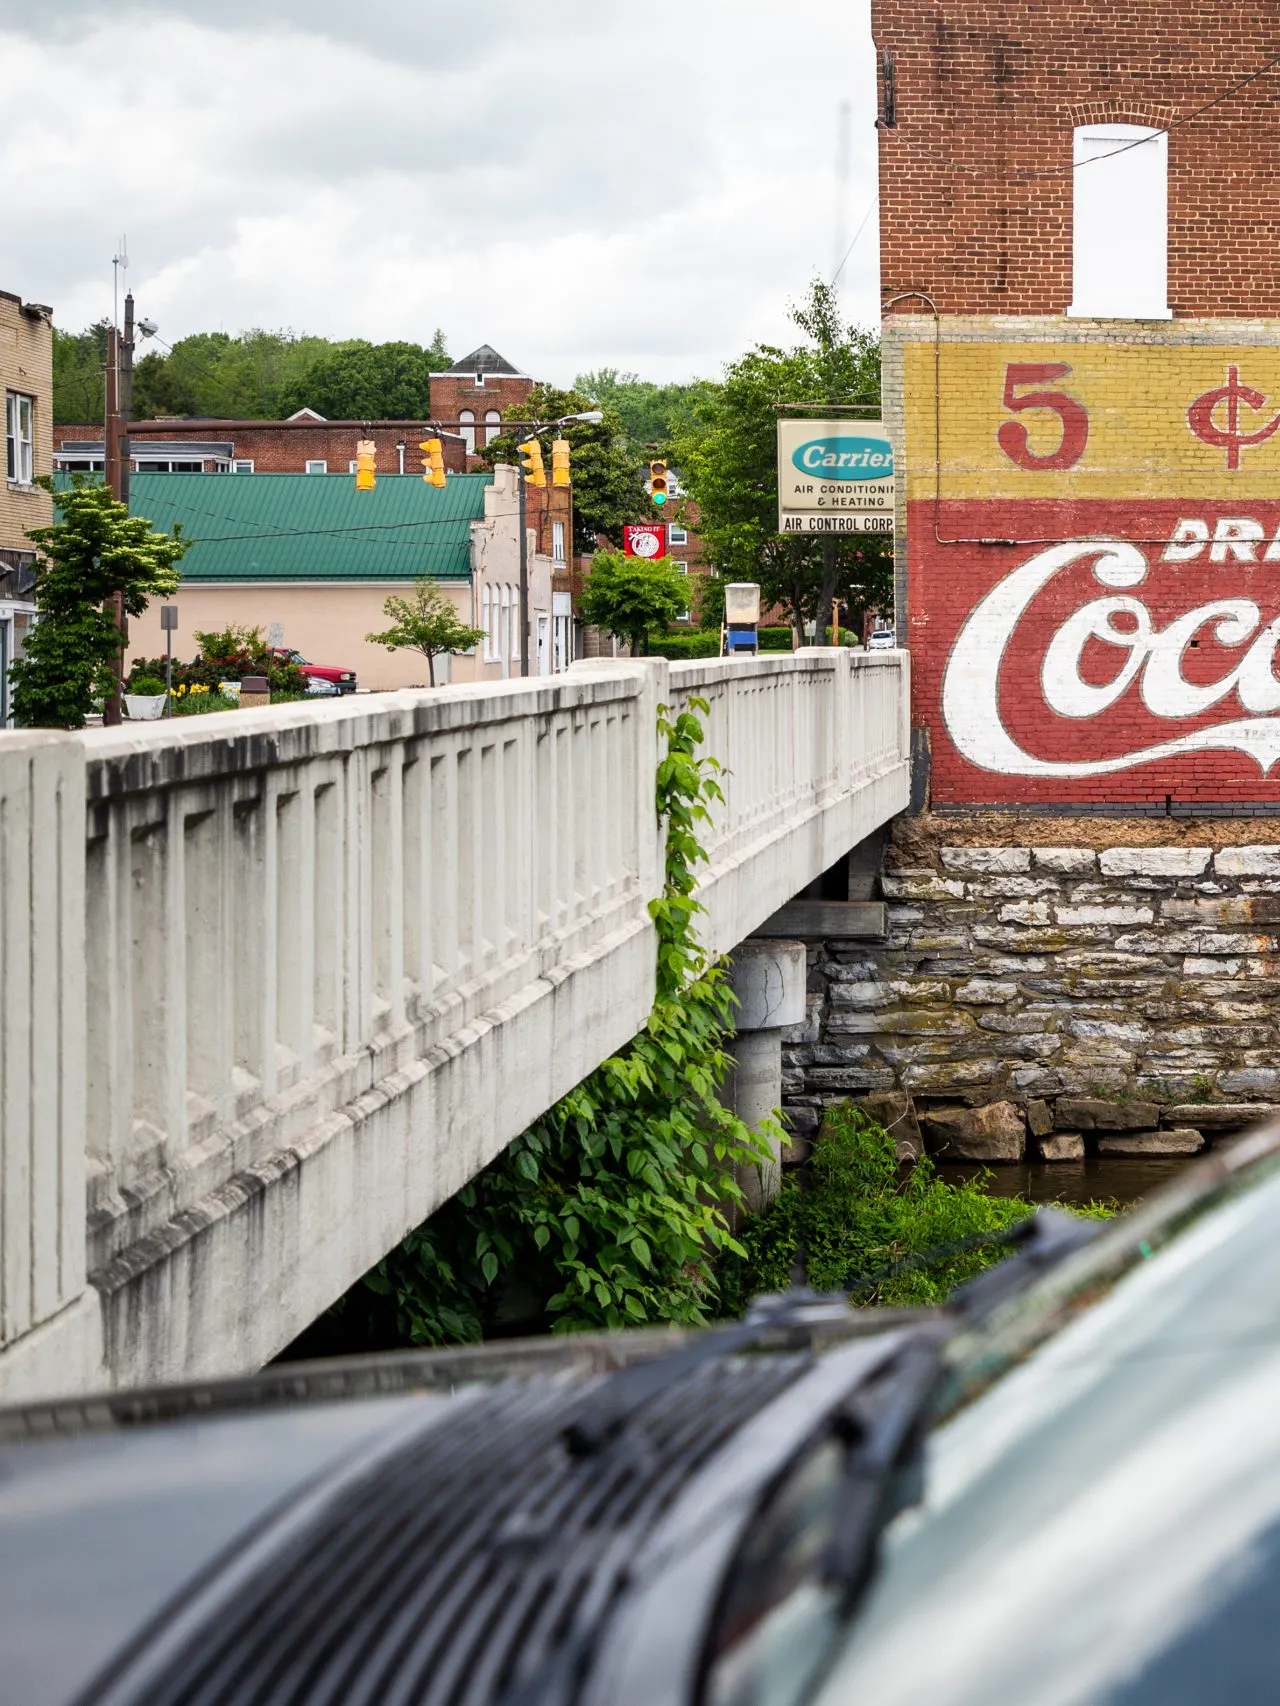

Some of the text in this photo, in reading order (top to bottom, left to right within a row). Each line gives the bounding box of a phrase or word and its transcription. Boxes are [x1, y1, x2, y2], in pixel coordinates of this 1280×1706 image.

[997, 361, 1089, 471] 5
[803, 445, 894, 468] Carrier
[794, 485, 813, 494] AIR
[817, 497, 884, 506] & HEATING
[785, 517, 802, 531] AIR
[809, 517, 859, 531] CONTROL
